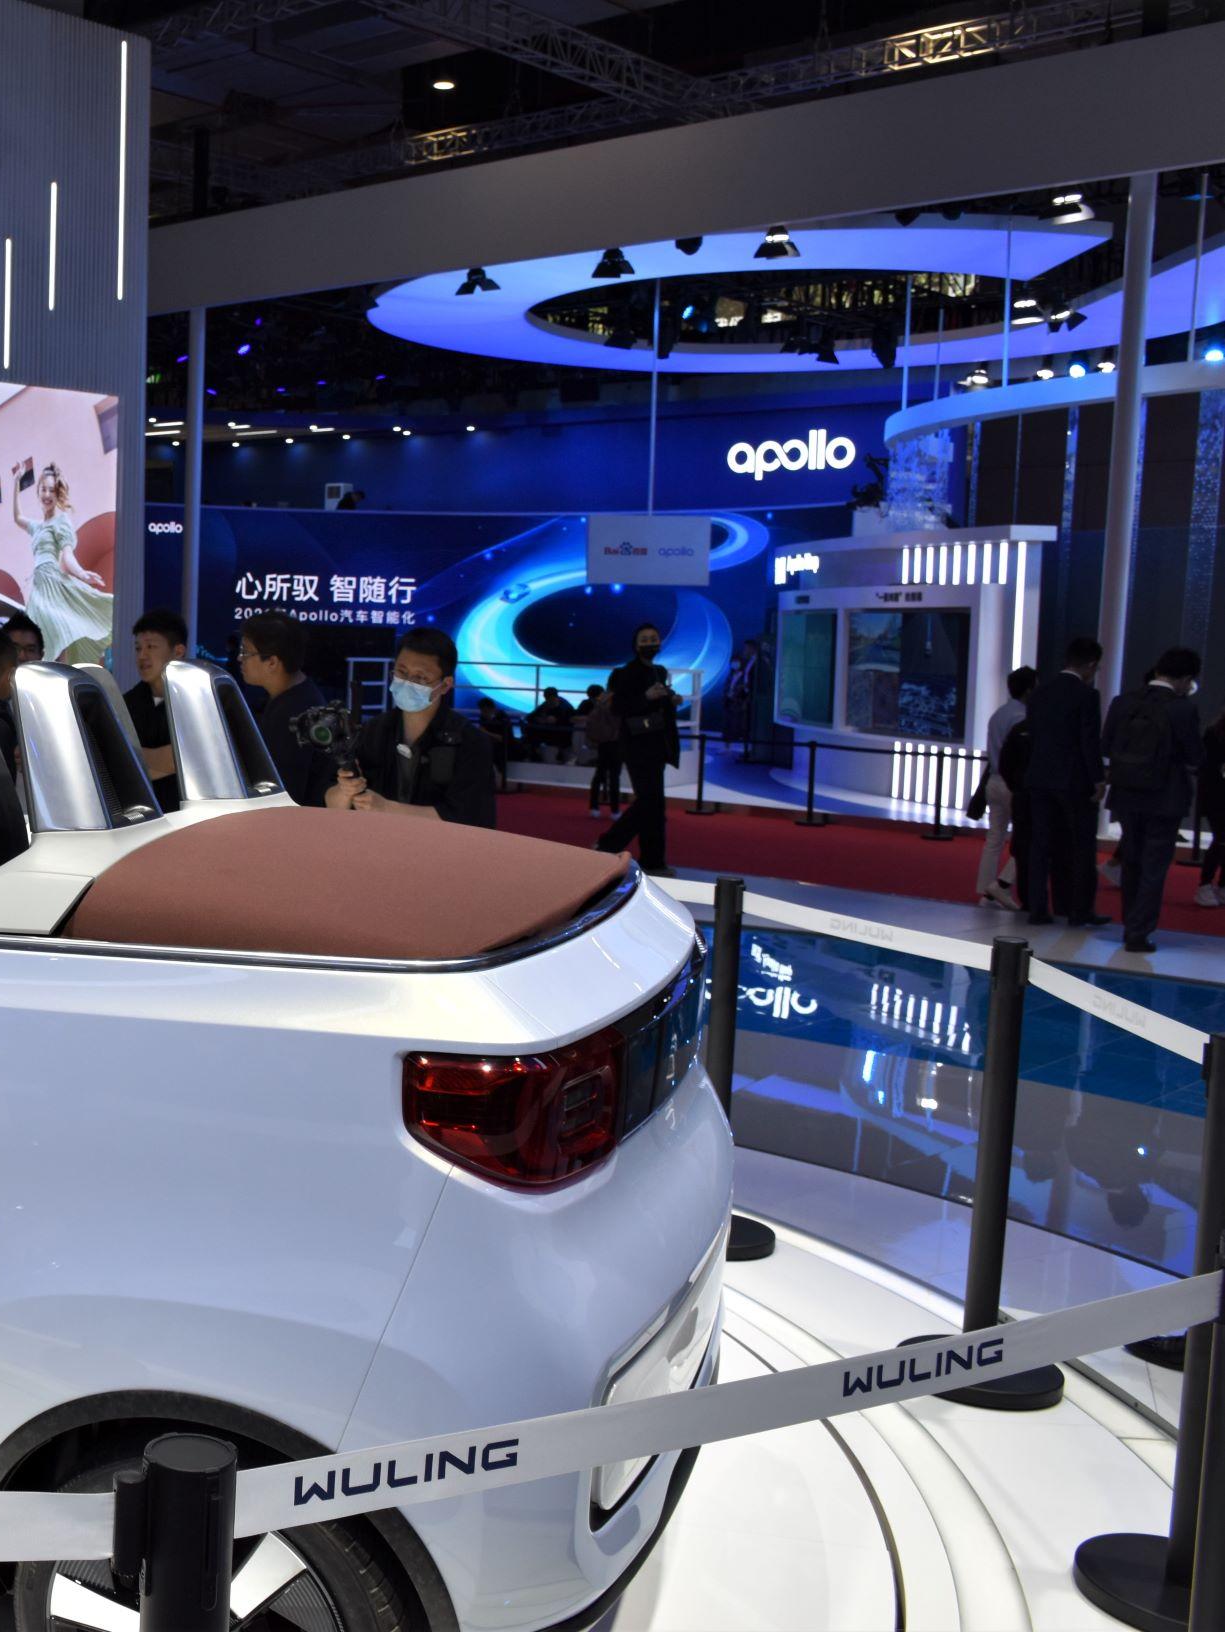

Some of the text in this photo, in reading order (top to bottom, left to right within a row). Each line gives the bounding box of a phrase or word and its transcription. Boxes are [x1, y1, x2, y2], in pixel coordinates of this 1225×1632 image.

[727, 428, 856, 481] apollo
[148, 521, 183, 535] apollo
[658, 546, 694, 558] apollo
[235, 572, 417, 604] 心所驭 智随行
[843, 1338, 1004, 1397] WULING
[294, 1438, 519, 1506] WULING
